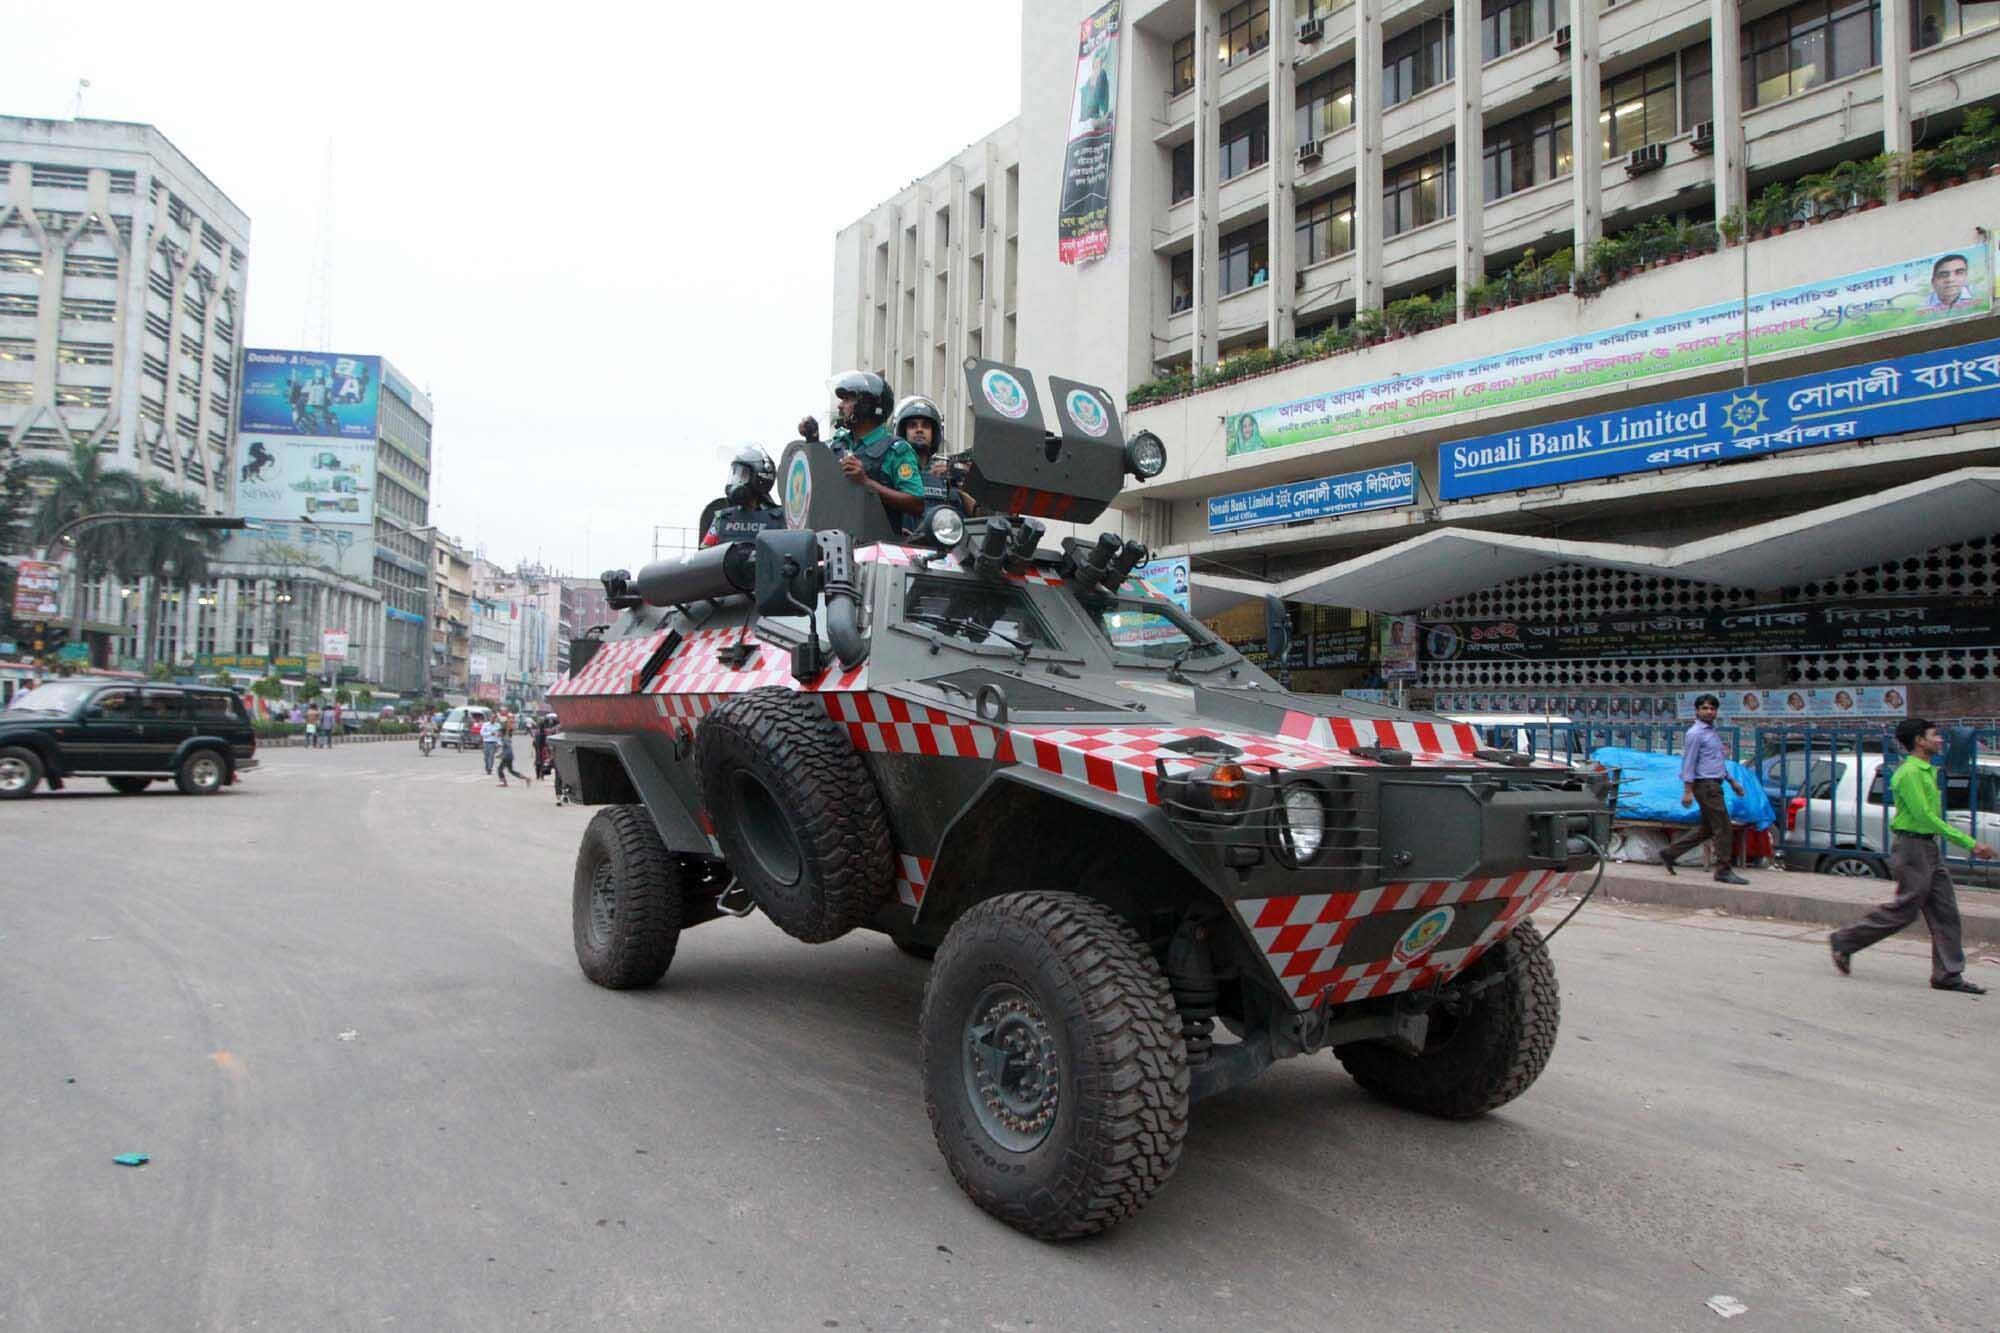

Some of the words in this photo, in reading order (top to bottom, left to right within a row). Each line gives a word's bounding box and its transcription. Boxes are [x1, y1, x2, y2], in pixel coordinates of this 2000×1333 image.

[1367, 398, 1400, 418] শেখ
[1406, 386, 1457, 409] হাসিনা
[1787, 367, 1901, 412] সোনালী
[1454, 437, 1521, 471] Sonali
[1528, 424, 1593, 457] Bank
[1600, 402, 1708, 446] Limited
[1645, 440, 1724, 464] প্রধান
[1732, 419, 1858, 449] কার্যালয়
[1210, 501, 1230, 516] Sonali
[1231, 497, 1248, 513] Bank
[1249, 492, 1275, 510] Limited
[1293, 481, 1330, 506] সোনালী
[1333, 480, 1363, 500] ব্যাংক
[1365, 471, 1412, 495] লিমিটেড
